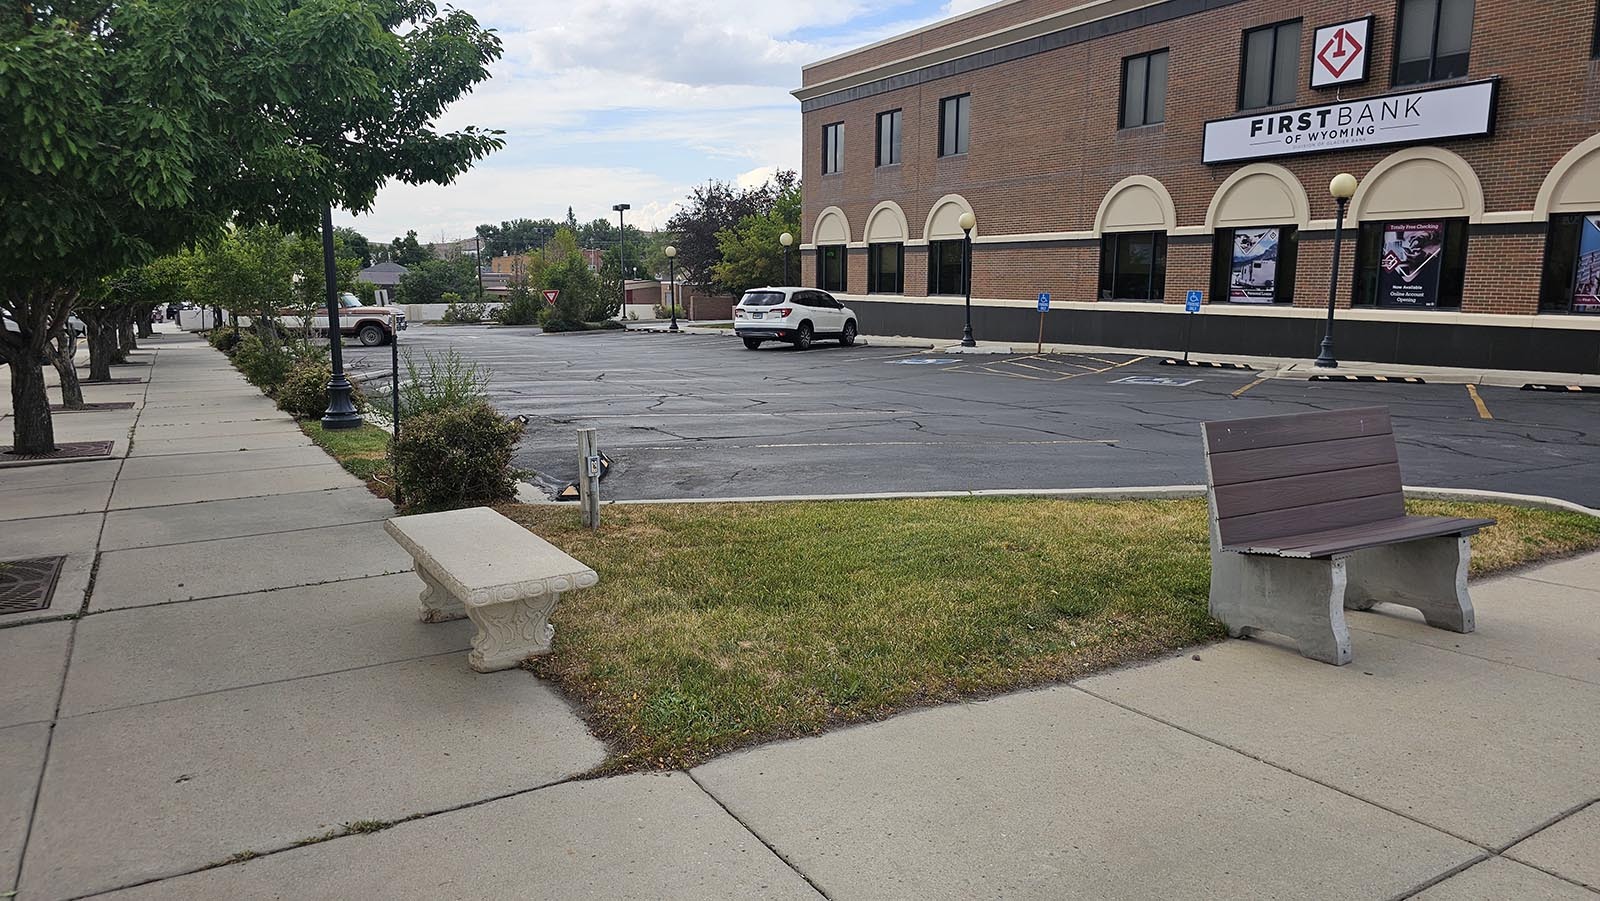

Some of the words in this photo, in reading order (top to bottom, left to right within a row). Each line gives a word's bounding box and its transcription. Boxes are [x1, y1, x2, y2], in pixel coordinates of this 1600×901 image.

[1333, 28, 1346, 58] 1
[1285, 134, 1302, 145] OF
[1308, 125, 1375, 142] WYOMING
